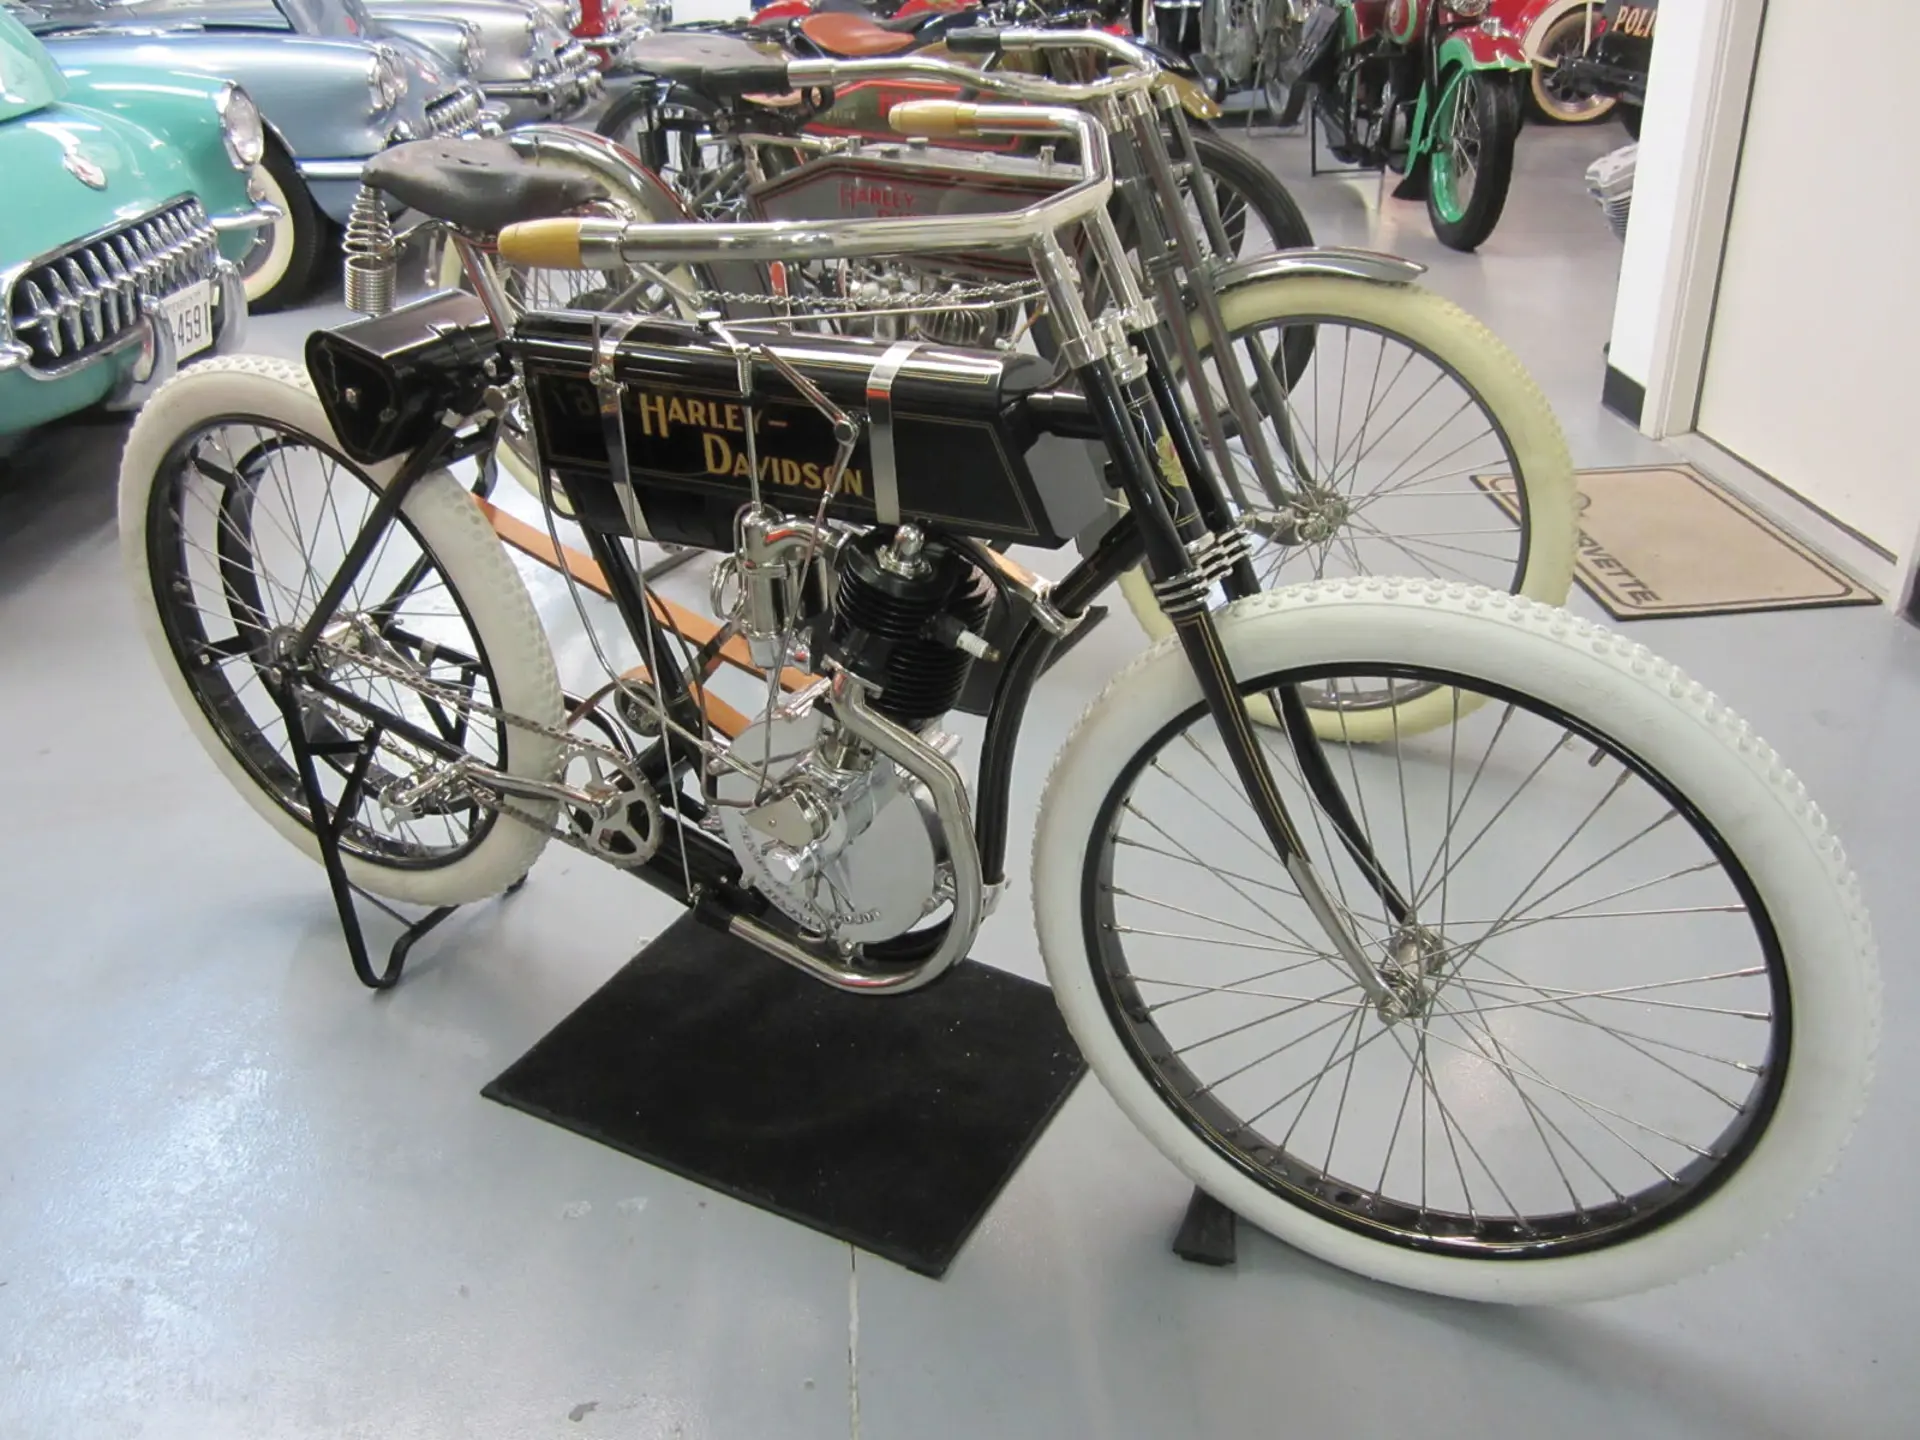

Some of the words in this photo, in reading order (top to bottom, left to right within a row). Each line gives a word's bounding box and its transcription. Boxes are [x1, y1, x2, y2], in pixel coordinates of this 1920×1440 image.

[1611, 5, 1657, 37] POLI
[839, 183, 914, 209] HARLEY
[1579, 528, 1663, 605] RVETTE
